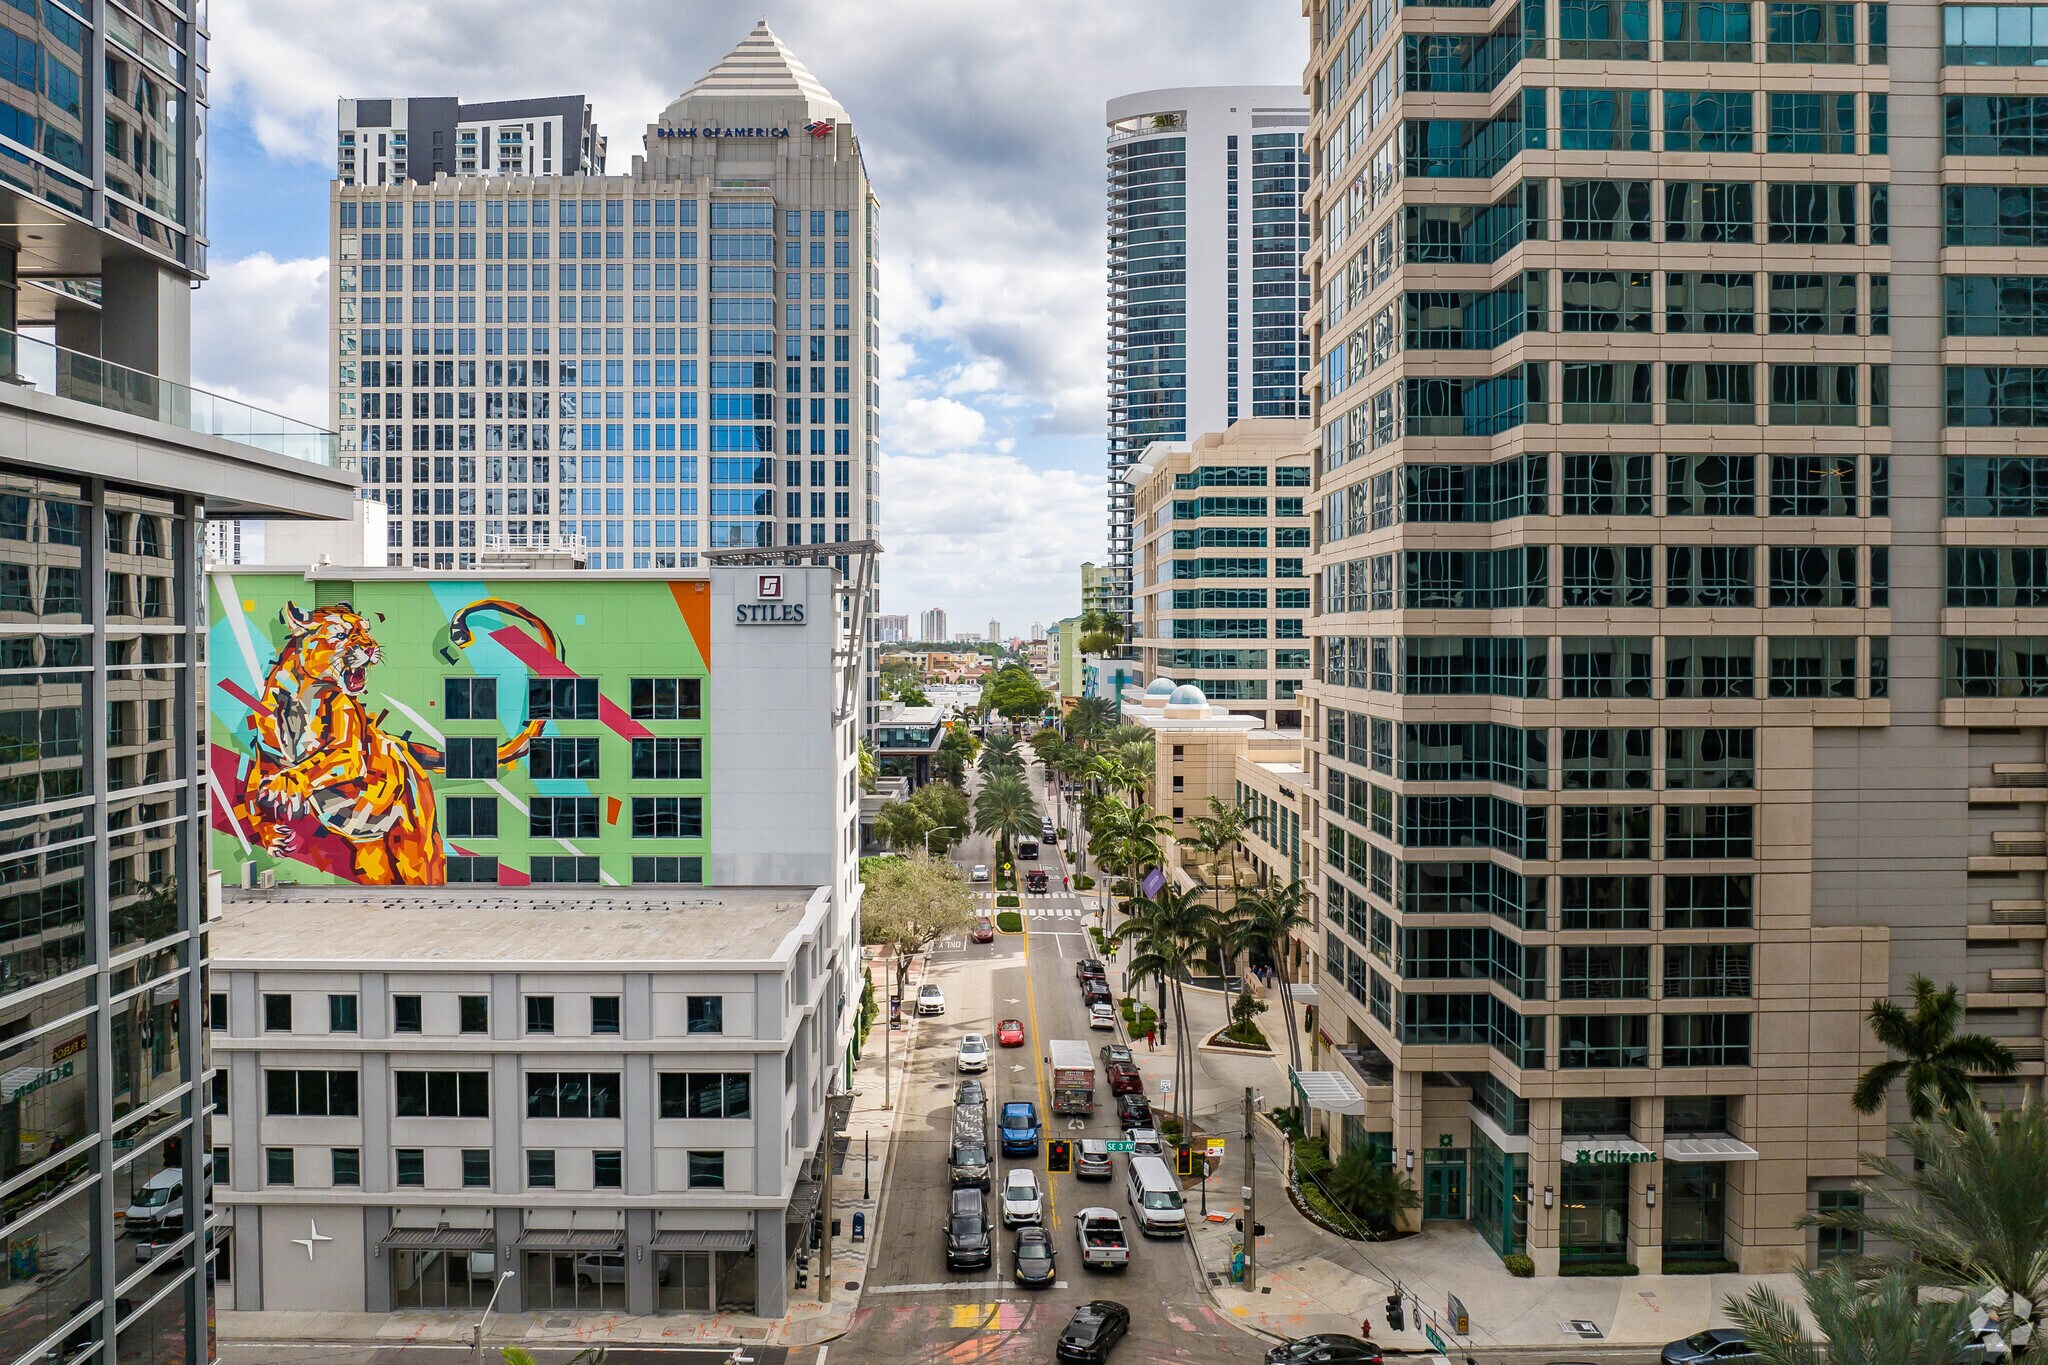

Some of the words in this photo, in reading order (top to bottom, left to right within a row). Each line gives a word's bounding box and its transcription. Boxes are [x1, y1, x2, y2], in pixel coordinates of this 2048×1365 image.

[657, 127, 698, 138] BANK
[702, 127, 721, 138] OF
[724, 127, 790, 138] AMERICA
[736, 603, 804, 622] STILES
[938, 941, 961, 949] ONLY
[1119, 1143, 1124, 1151] 3
[1594, 1149, 1658, 1164] Citizens
